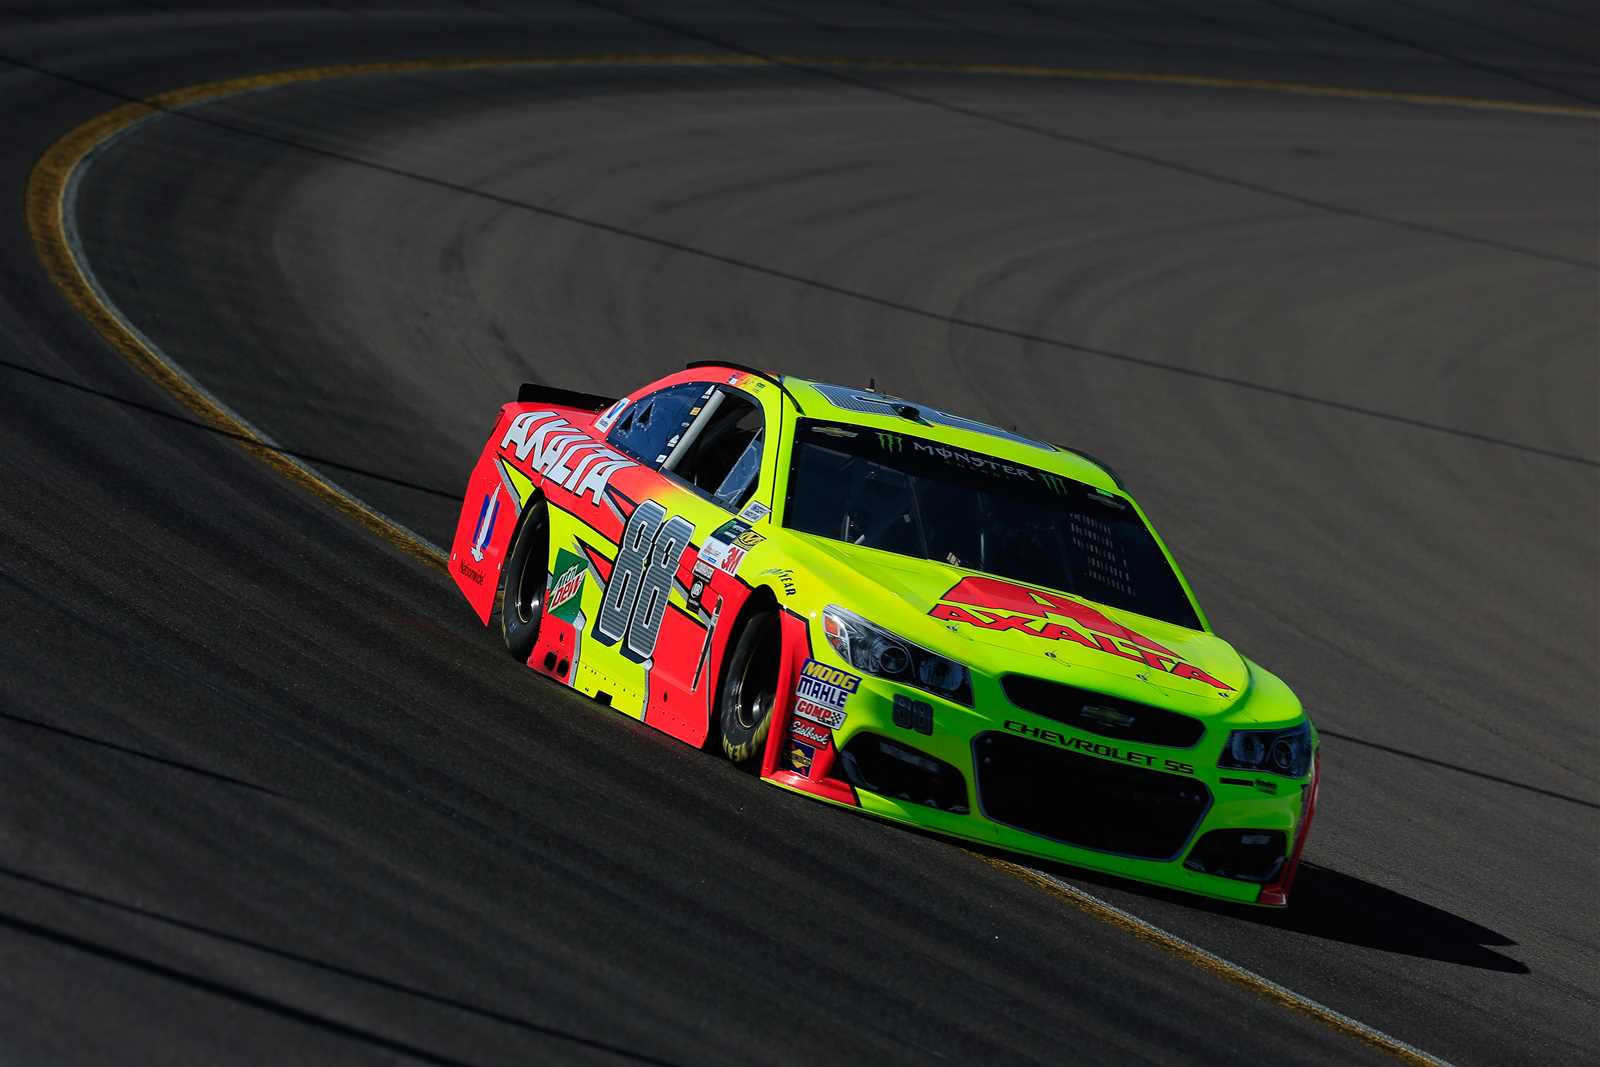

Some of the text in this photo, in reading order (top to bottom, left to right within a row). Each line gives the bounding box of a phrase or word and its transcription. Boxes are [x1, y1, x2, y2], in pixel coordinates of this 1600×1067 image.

[721, 546, 746, 575] 3M
[592, 499, 696, 663] 88
[928, 603, 1238, 692] AXALTA
[797, 677, 848, 708] MAHLE
[804, 661, 859, 690] MOOG
[797, 700, 832, 719] COMP
[892, 693, 934, 736] 88
[1003, 719, 1194, 776] CHEVROLET SS
